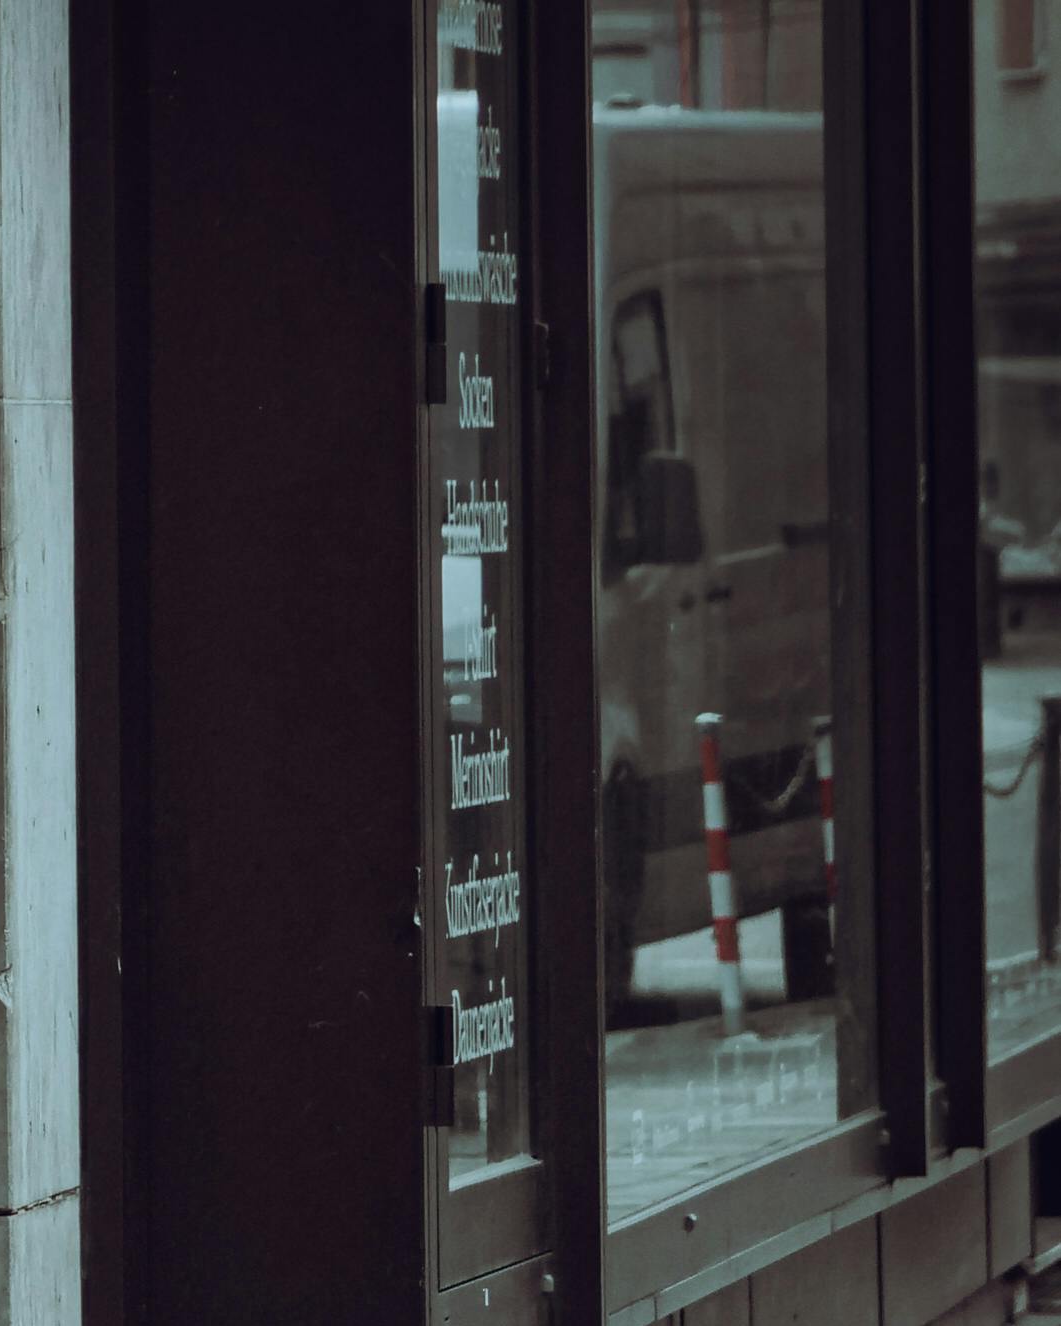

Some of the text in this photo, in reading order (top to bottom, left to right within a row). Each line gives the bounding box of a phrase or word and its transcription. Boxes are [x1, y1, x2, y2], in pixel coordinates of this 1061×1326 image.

[459, 352, 494, 428] Socken
[446, 479, 508, 554] Handschuhe
[450, 728, 510, 809] Merinoshirt
[452, 976, 514, 1075] Daunenjacke
